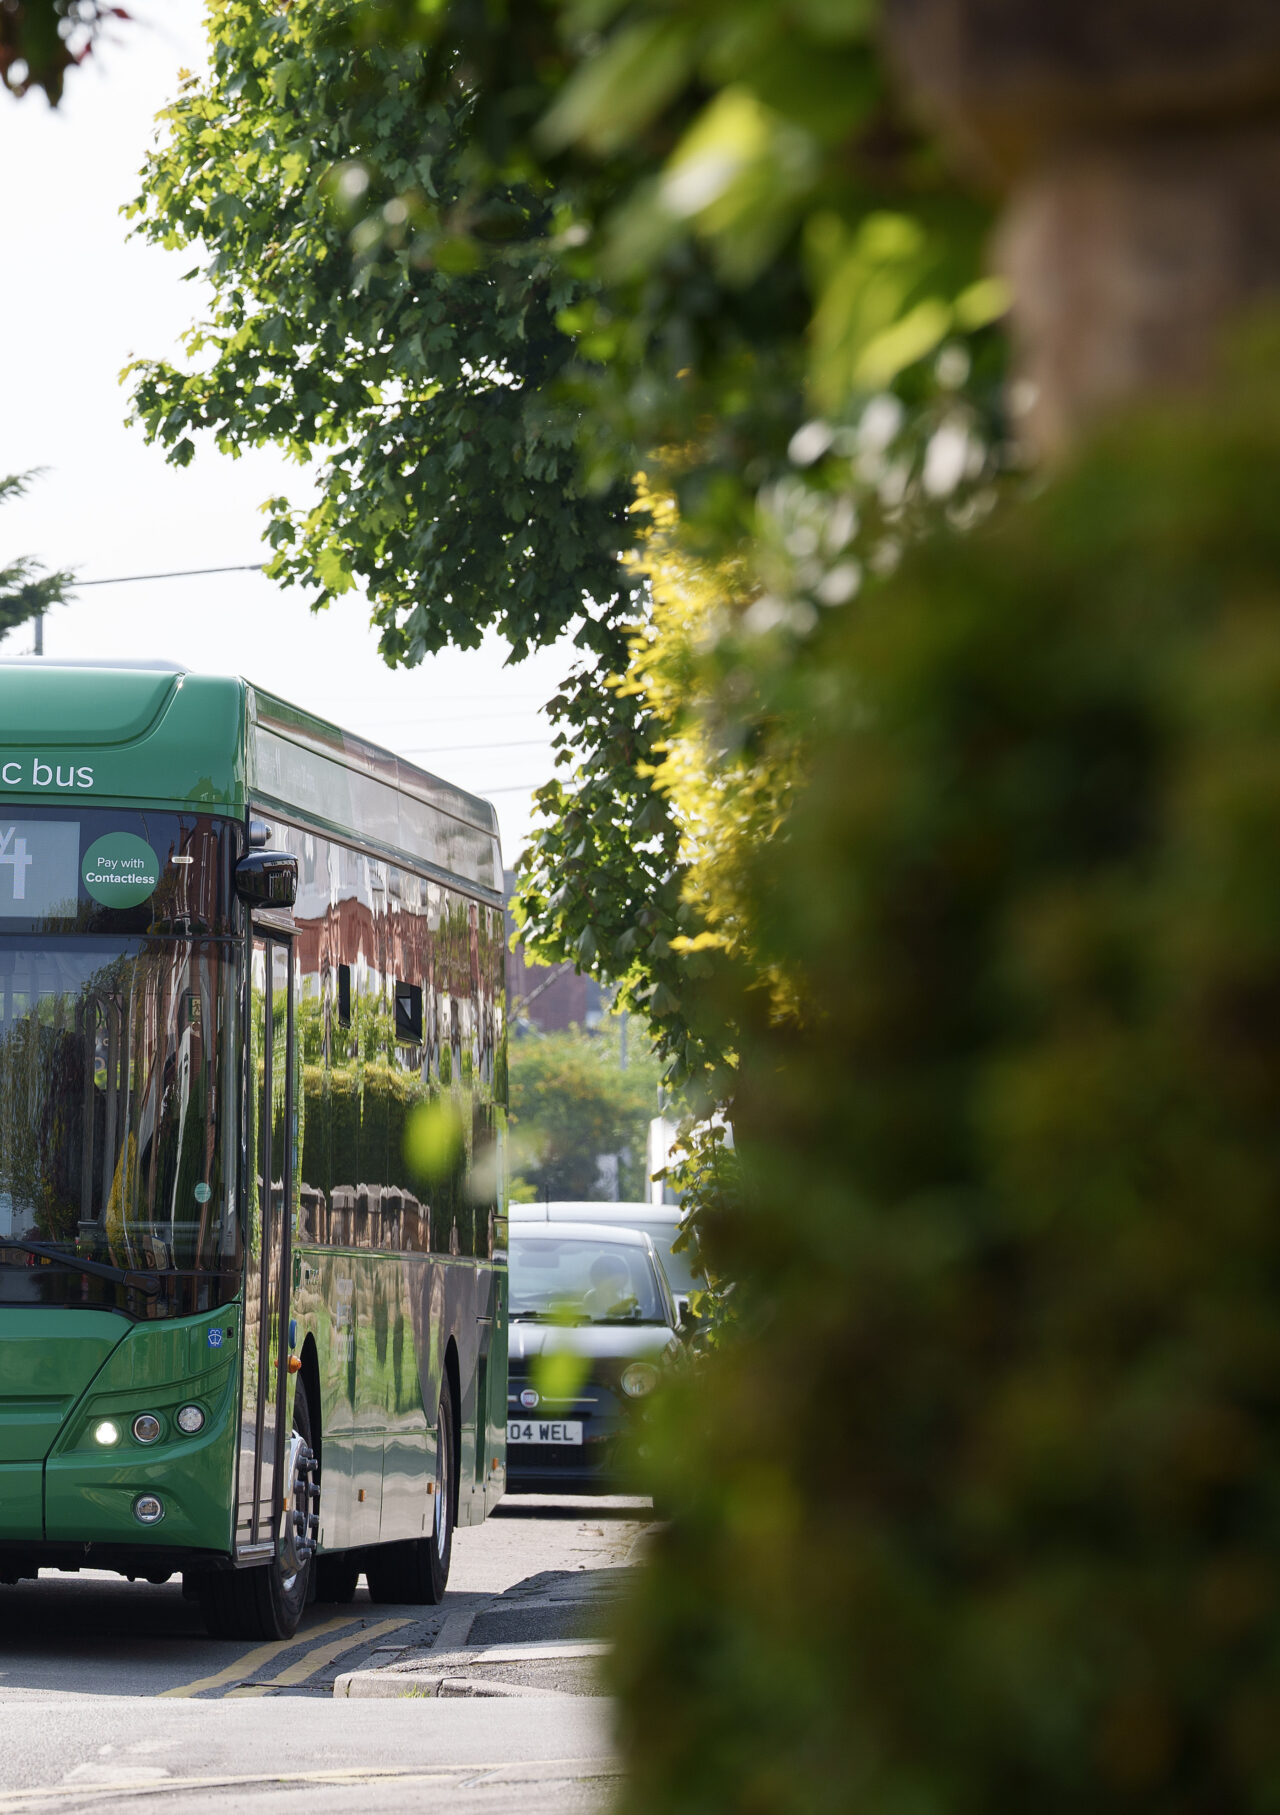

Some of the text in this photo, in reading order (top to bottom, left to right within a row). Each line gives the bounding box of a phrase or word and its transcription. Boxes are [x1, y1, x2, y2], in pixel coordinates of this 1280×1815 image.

[32, 758, 94, 788] bus
[97, 857, 144, 869] Pay with
[86, 872, 155, 884] Contactless
[506, 1424, 574, 1441] 04 WEL
